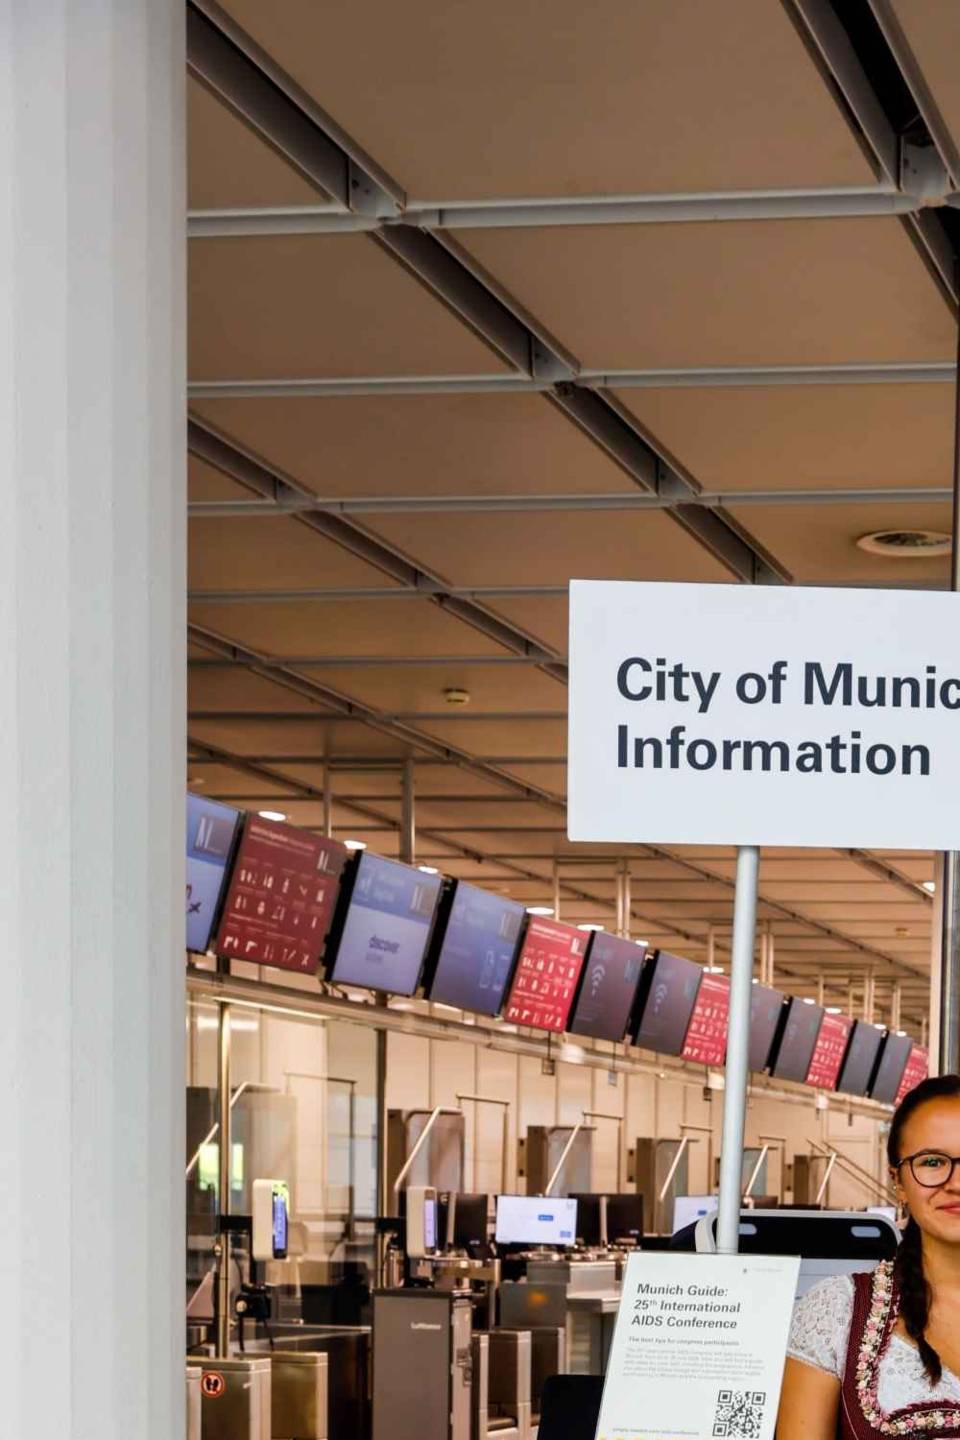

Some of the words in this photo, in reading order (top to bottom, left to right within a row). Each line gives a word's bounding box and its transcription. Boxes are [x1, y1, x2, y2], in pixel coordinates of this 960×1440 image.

[616, 656, 721, 714] City
[735, 660, 788, 705] of
[617, 724, 930, 776] Information
[636, 1283, 684, 1296] Munich
[687, 1284, 729, 1297] Guide:
[633, 1299, 658, 1311] 25th
[659, 1300, 741, 1313] International
[631, 1314, 664, 1327] AIDS
[666, 1316, 738, 1329] Conference
